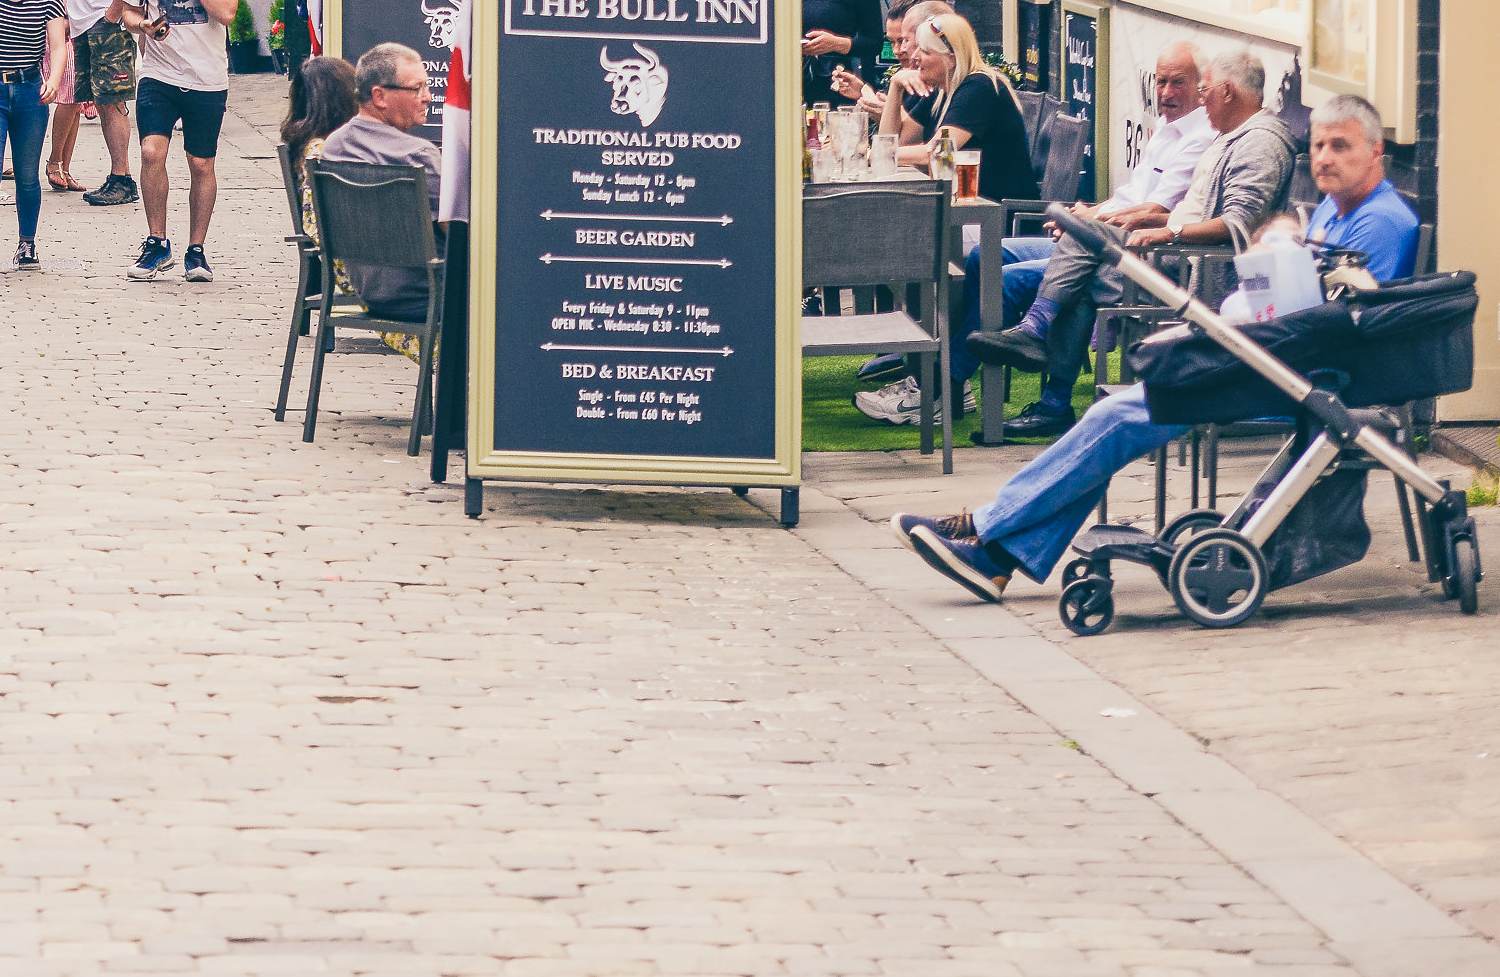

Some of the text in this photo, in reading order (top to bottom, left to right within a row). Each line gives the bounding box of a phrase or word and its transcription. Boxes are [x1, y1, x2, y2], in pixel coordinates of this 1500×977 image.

[533, 129, 742, 149] TRADITIONAL PUB FOOD
[601, 150, 674, 167] SERVED
[572, 170, 605, 187] Monday
[614, 173, 651, 189] Saturday
[654, 174, 666, 186] 12
[582, 188, 685, 206] Sunday Lunch 12 6pm
[575, 229, 696, 247] BEER GARDEN
[585, 275, 683, 292] LIVE MUSIC
[562, 301, 710, 320] Every Friday & Saturday 9 11pm
[551, 318, 576, 330] OPEN
[603, 320, 650, 335] Wednesday
[683, 321, 721, 337] 11:30pm
[562, 363, 715, 382] BED & BREAKFAST
[578, 389, 701, 408] Single From £45 Per Night
[576, 406, 703, 425] Double From £60 Per Night
